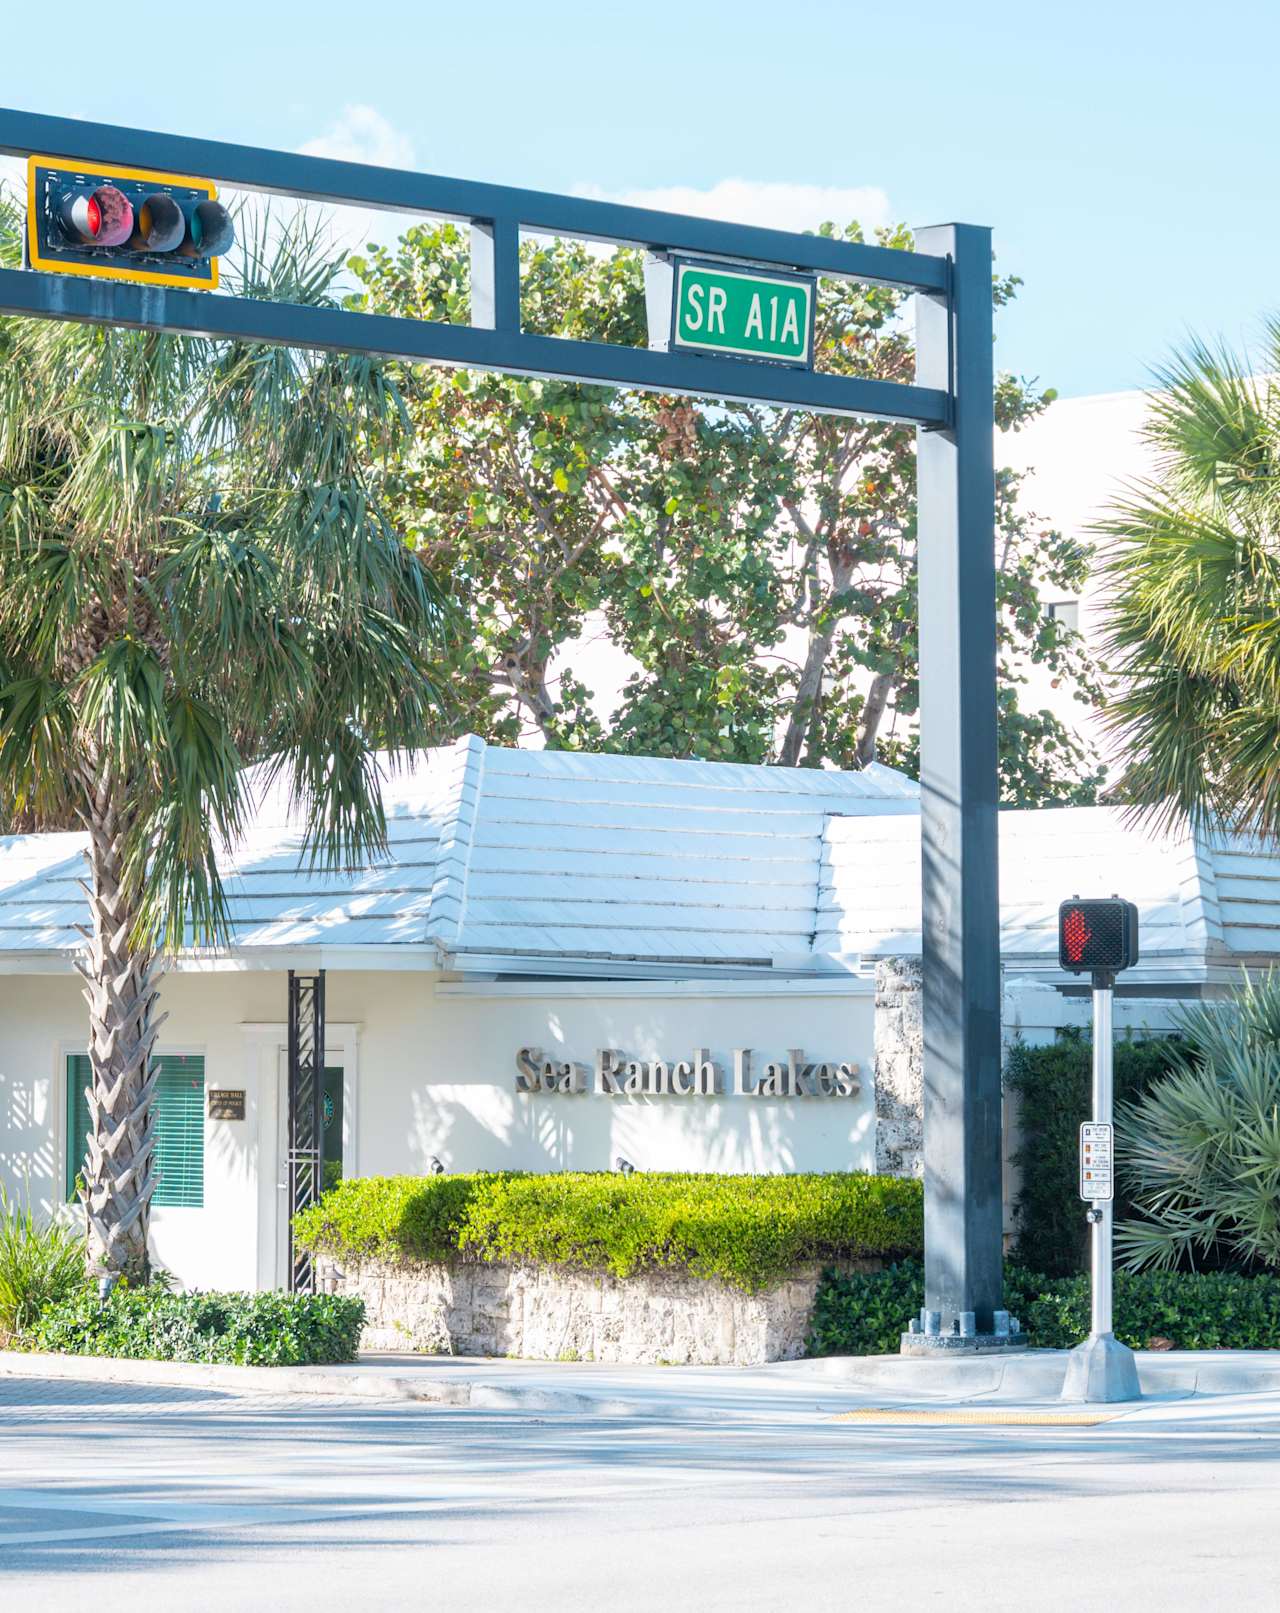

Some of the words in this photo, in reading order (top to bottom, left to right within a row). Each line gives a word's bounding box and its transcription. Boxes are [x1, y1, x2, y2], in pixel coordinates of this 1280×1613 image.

[685, 283, 727, 334] SR
[744, 293, 799, 345] A1A
[516, 1047, 580, 1094] Sea
[593, 1048, 721, 1096] Ranch
[731, 1048, 861, 1097] Lakes
